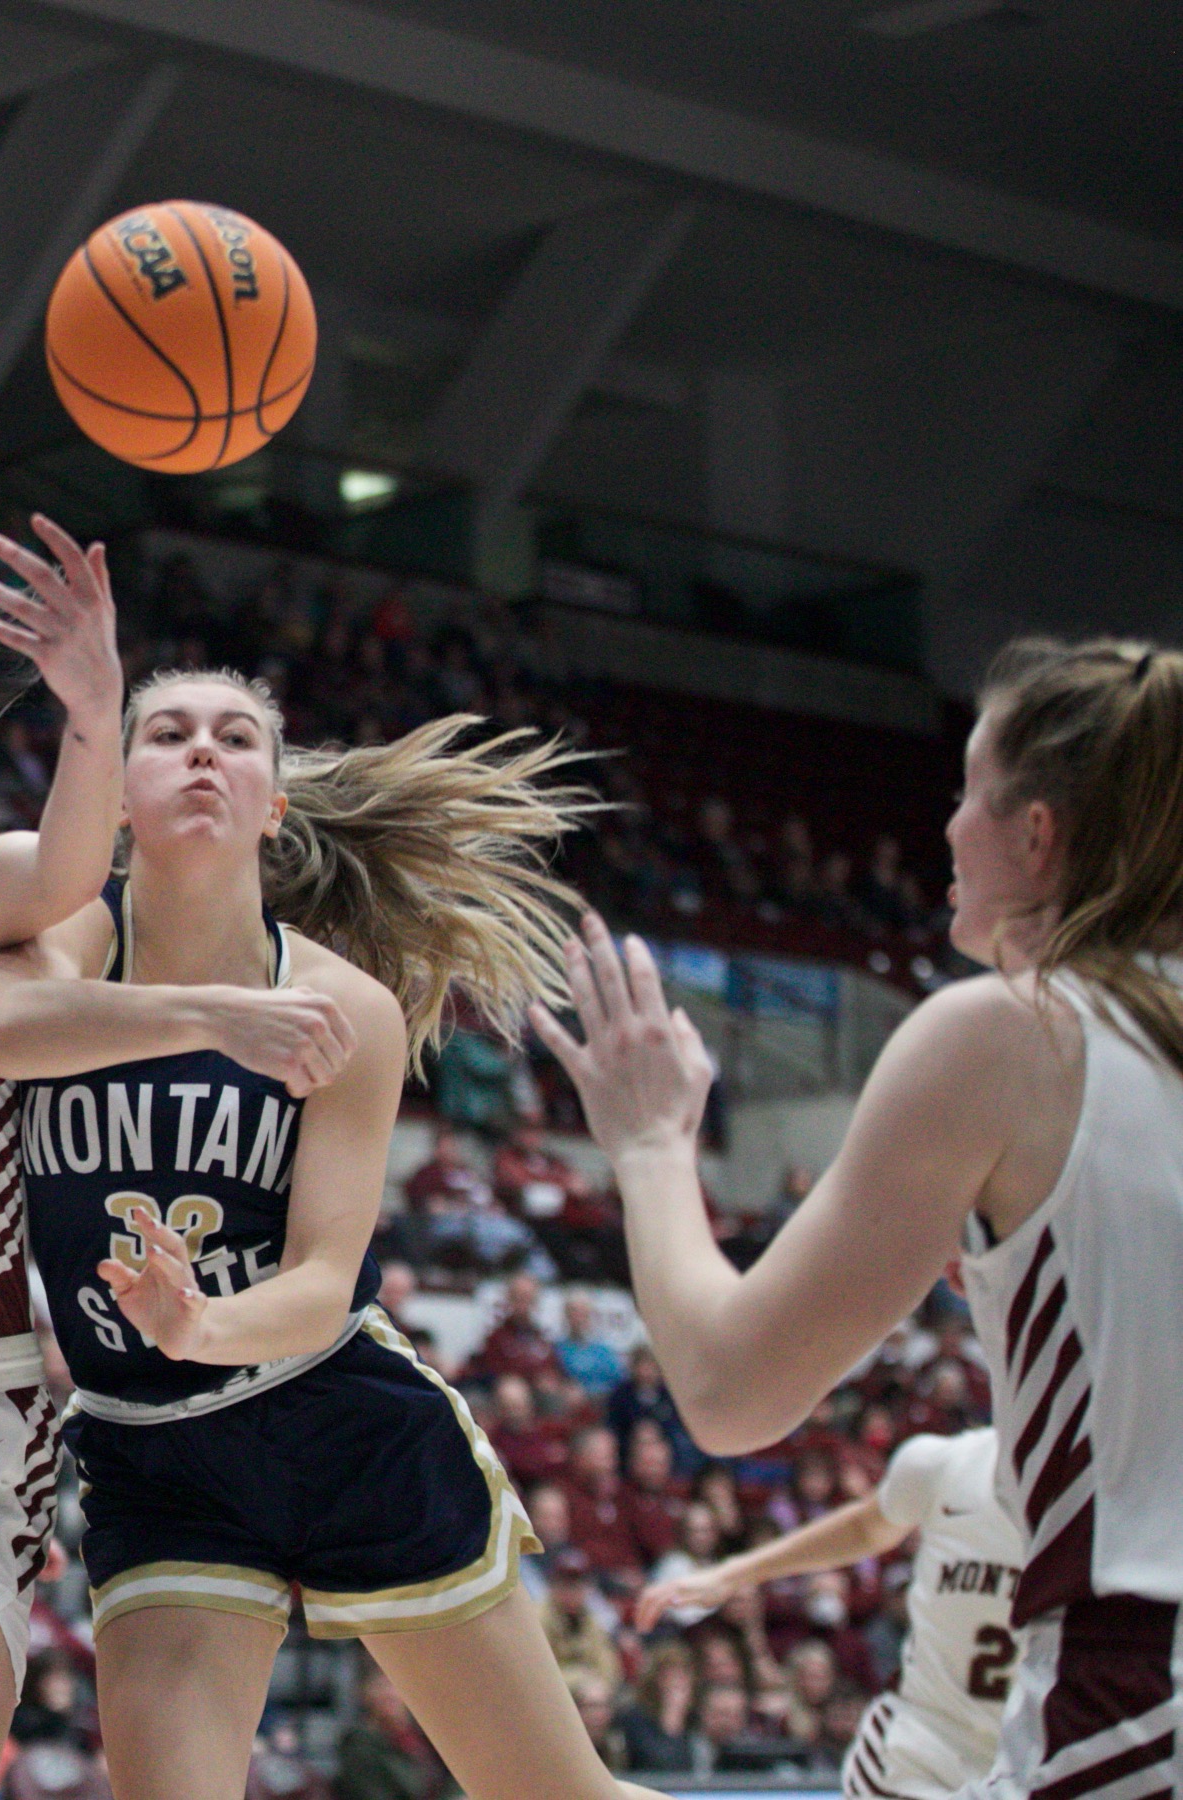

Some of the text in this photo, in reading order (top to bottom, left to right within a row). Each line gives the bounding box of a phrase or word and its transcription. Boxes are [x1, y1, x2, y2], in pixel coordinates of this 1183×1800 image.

[214, 213, 259, 300] son
[21, 1082, 296, 1194] MONTAN
[104, 1191, 224, 1272] 32
[77, 1241, 279, 1352] STE
